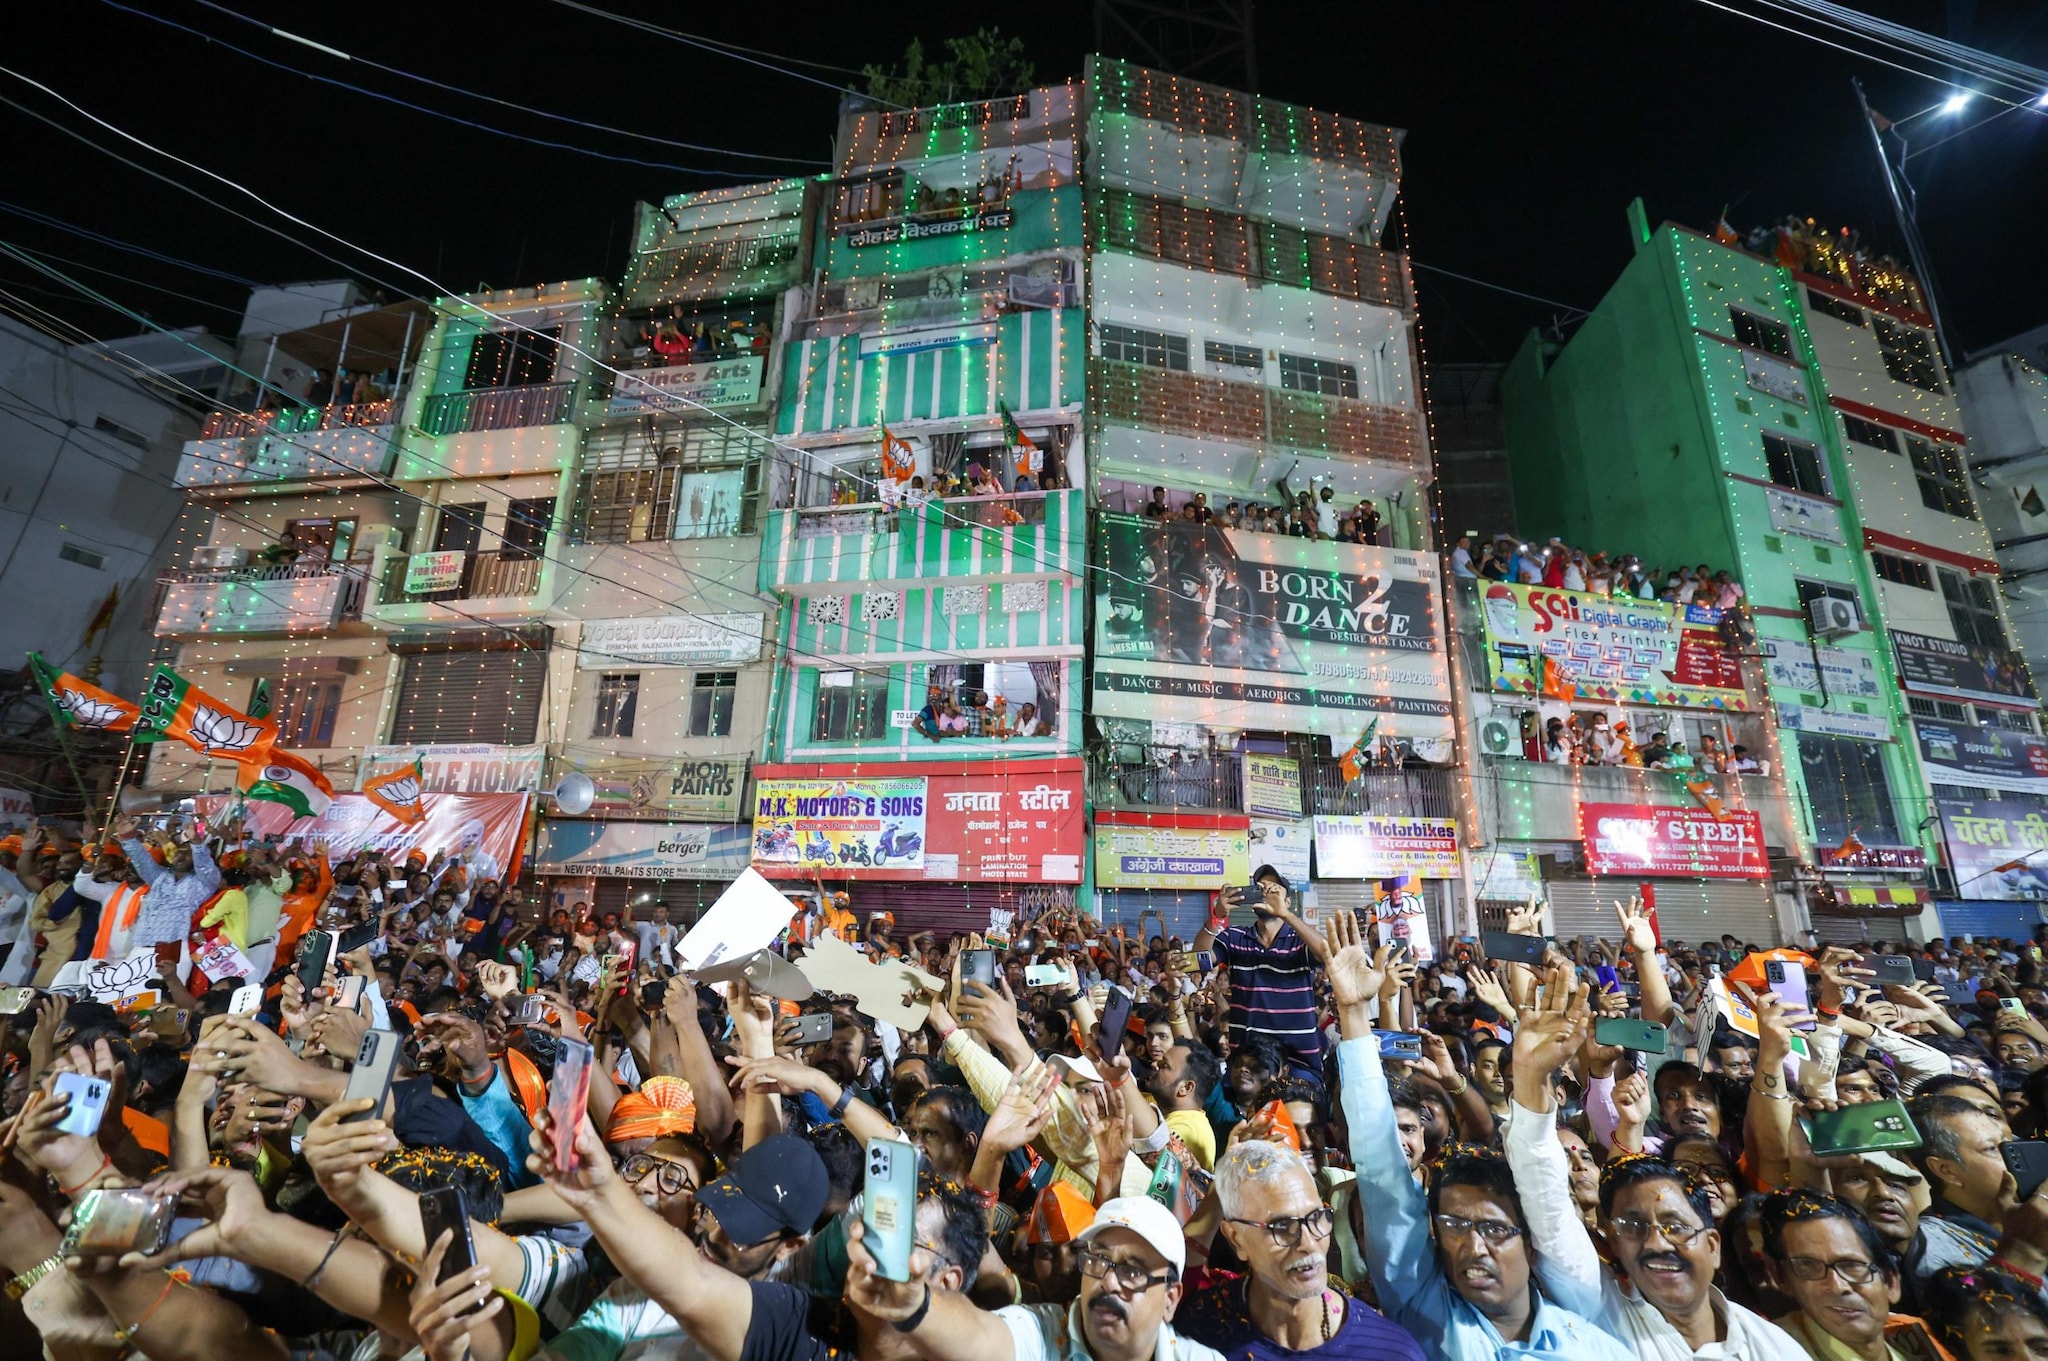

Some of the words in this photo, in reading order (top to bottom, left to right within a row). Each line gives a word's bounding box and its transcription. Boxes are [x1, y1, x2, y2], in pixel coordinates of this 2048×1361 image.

[985, 213, 1011, 227] घर
[623, 370, 697, 389] Prince
[702, 364, 751, 382] Arts
[1257, 569, 1354, 603] BORN
[1354, 568, 1393, 614] 2
[1284, 601, 1411, 637] DANCE
[1528, 591, 1580, 633] Sai
[1583, 608, 1622, 628] Digital
[587, 622, 639, 642] YOGESH
[644, 620, 703, 641] COURIER
[1330, 631, 1368, 644] DESIRE
[1370, 634, 1397, 647] MEET
[1399, 639, 1434, 651] DANCE
[1565, 627, 1599, 641] Flex
[1611, 630, 1678, 651] Printing
[1894, 632, 1925, 648] KNOT
[1928, 639, 1969, 657] STUDIO
[671, 651, 696, 661] OVER
[699, 650, 726, 660] INDIA
[1121, 677, 1162, 689] DANCE
[1186, 682, 1223, 695] MUSIC
[1246, 688, 1300, 702] AEROBICS
[1320, 694, 1376, 708] MODELING
[1398, 701, 1449, 714] PAINTINGS
[466, 759, 540, 793] HOME
[680, 761, 729, 781] MODI
[671, 776, 734, 797] PAINTS
[759, 797, 790, 816] M.K.
[796, 796, 860, 817] MOTORS
[865, 797, 876, 817] &
[881, 796, 923, 817] SONS
[943, 791, 1003, 812] जनता
[1018, 784, 1071, 812] स्टील
[800, 822, 822, 830] Sale
[832, 822, 878, 830] Purchase
[1317, 820, 1364, 836] Union
[1369, 821, 1455, 838] Motorbikes
[1668, 820, 1753, 843] STEEL
[1949, 807, 2012, 848] चंदन
[657, 840, 706, 859] Berger
[1387, 852, 1404, 860] (Car
[1414, 852, 1435, 860] Bikes
[1437, 853, 1458, 862] Only)
[564, 864, 584, 876] NEW
[586, 865, 613, 877] ROYAL
[614, 866, 644, 877] PAINTS
[646, 867, 675, 878] STORE
[981, 862, 1028, 870] LAMINATION
[1127, 857, 1166, 873] अंग्रेजी
